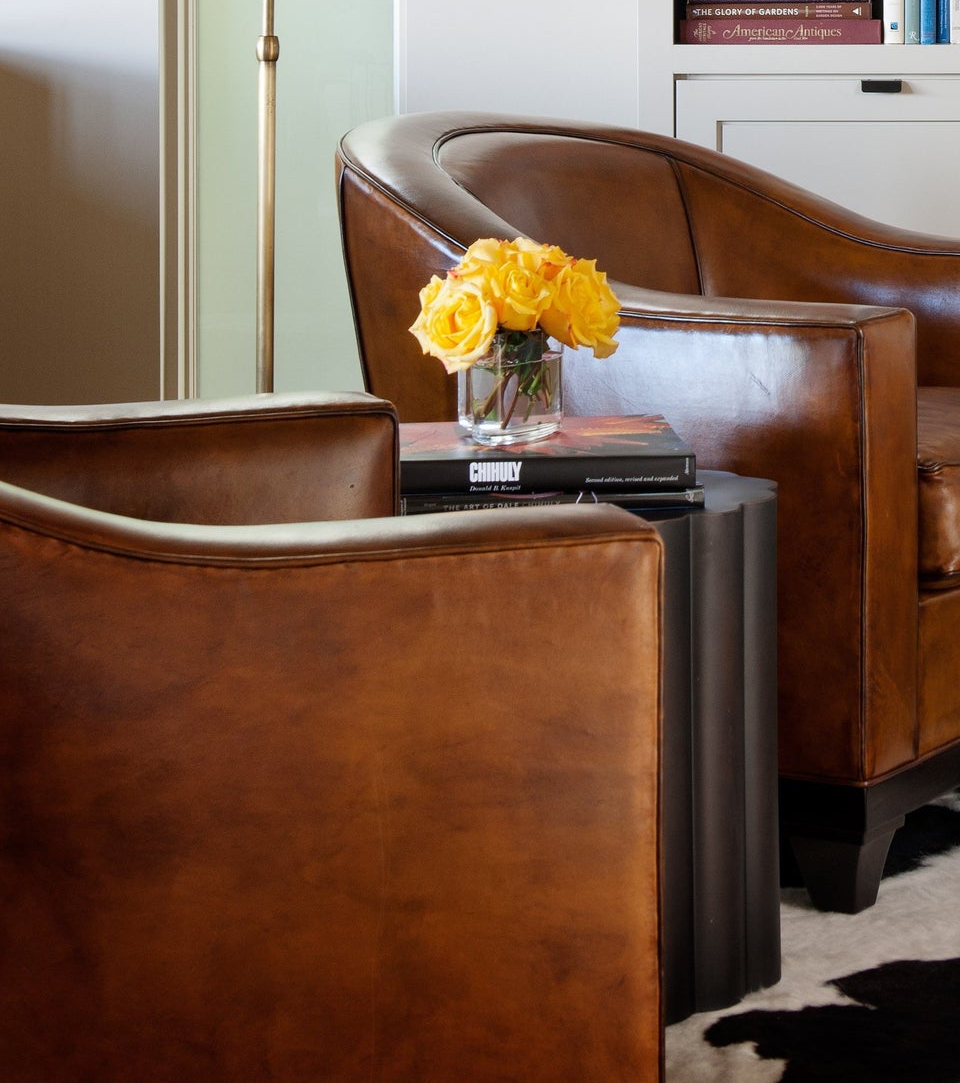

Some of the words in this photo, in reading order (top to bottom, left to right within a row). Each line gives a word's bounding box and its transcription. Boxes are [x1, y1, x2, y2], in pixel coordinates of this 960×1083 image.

[695, 8, 713, 16] THE
[714, 8, 742, 16] GLORY
[745, 8, 757, 16] OF
[758, 8, 799, 16] GARDENS
[469, 461, 523, 483] CHIHULY
